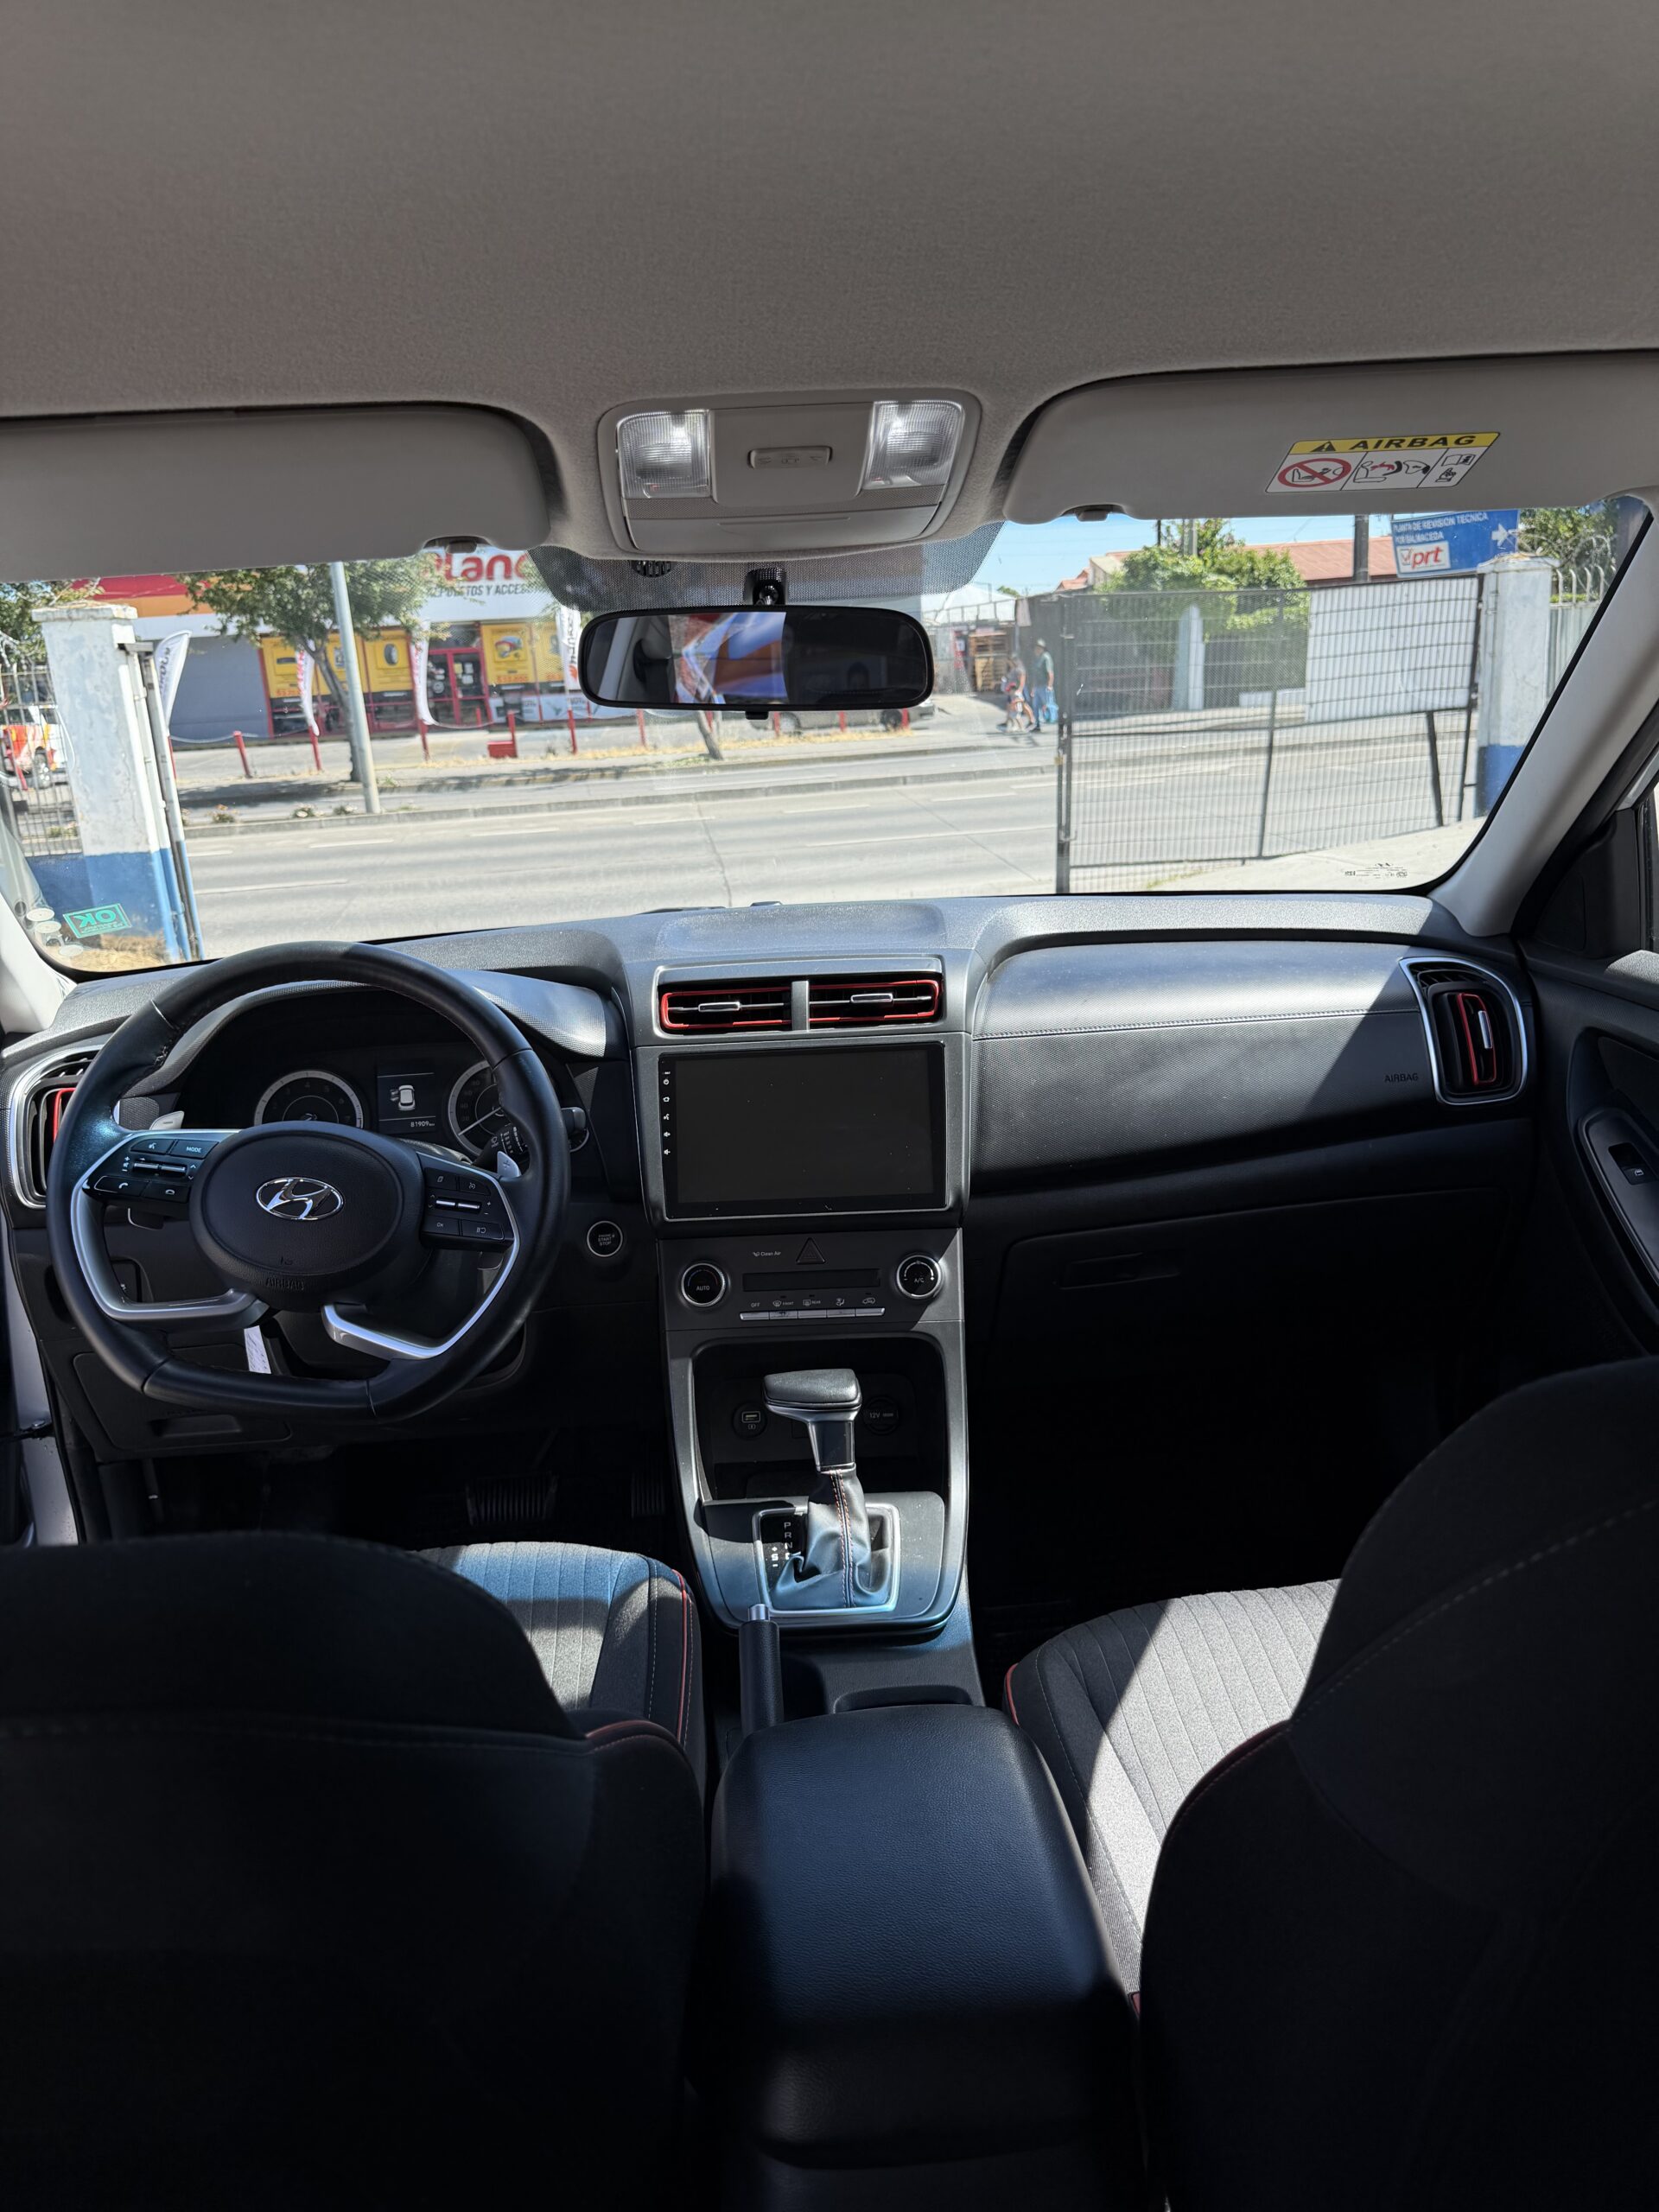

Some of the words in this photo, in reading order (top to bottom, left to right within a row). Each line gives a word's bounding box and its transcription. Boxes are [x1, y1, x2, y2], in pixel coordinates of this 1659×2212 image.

[1349, 435, 1478, 450] AIRBAG
[1411, 546, 1444, 569] prt
[486, 585, 493, 595] Y
[1384, 1072, 1419, 1084] AIRBAG
[784, 1522, 791, 1530] P
